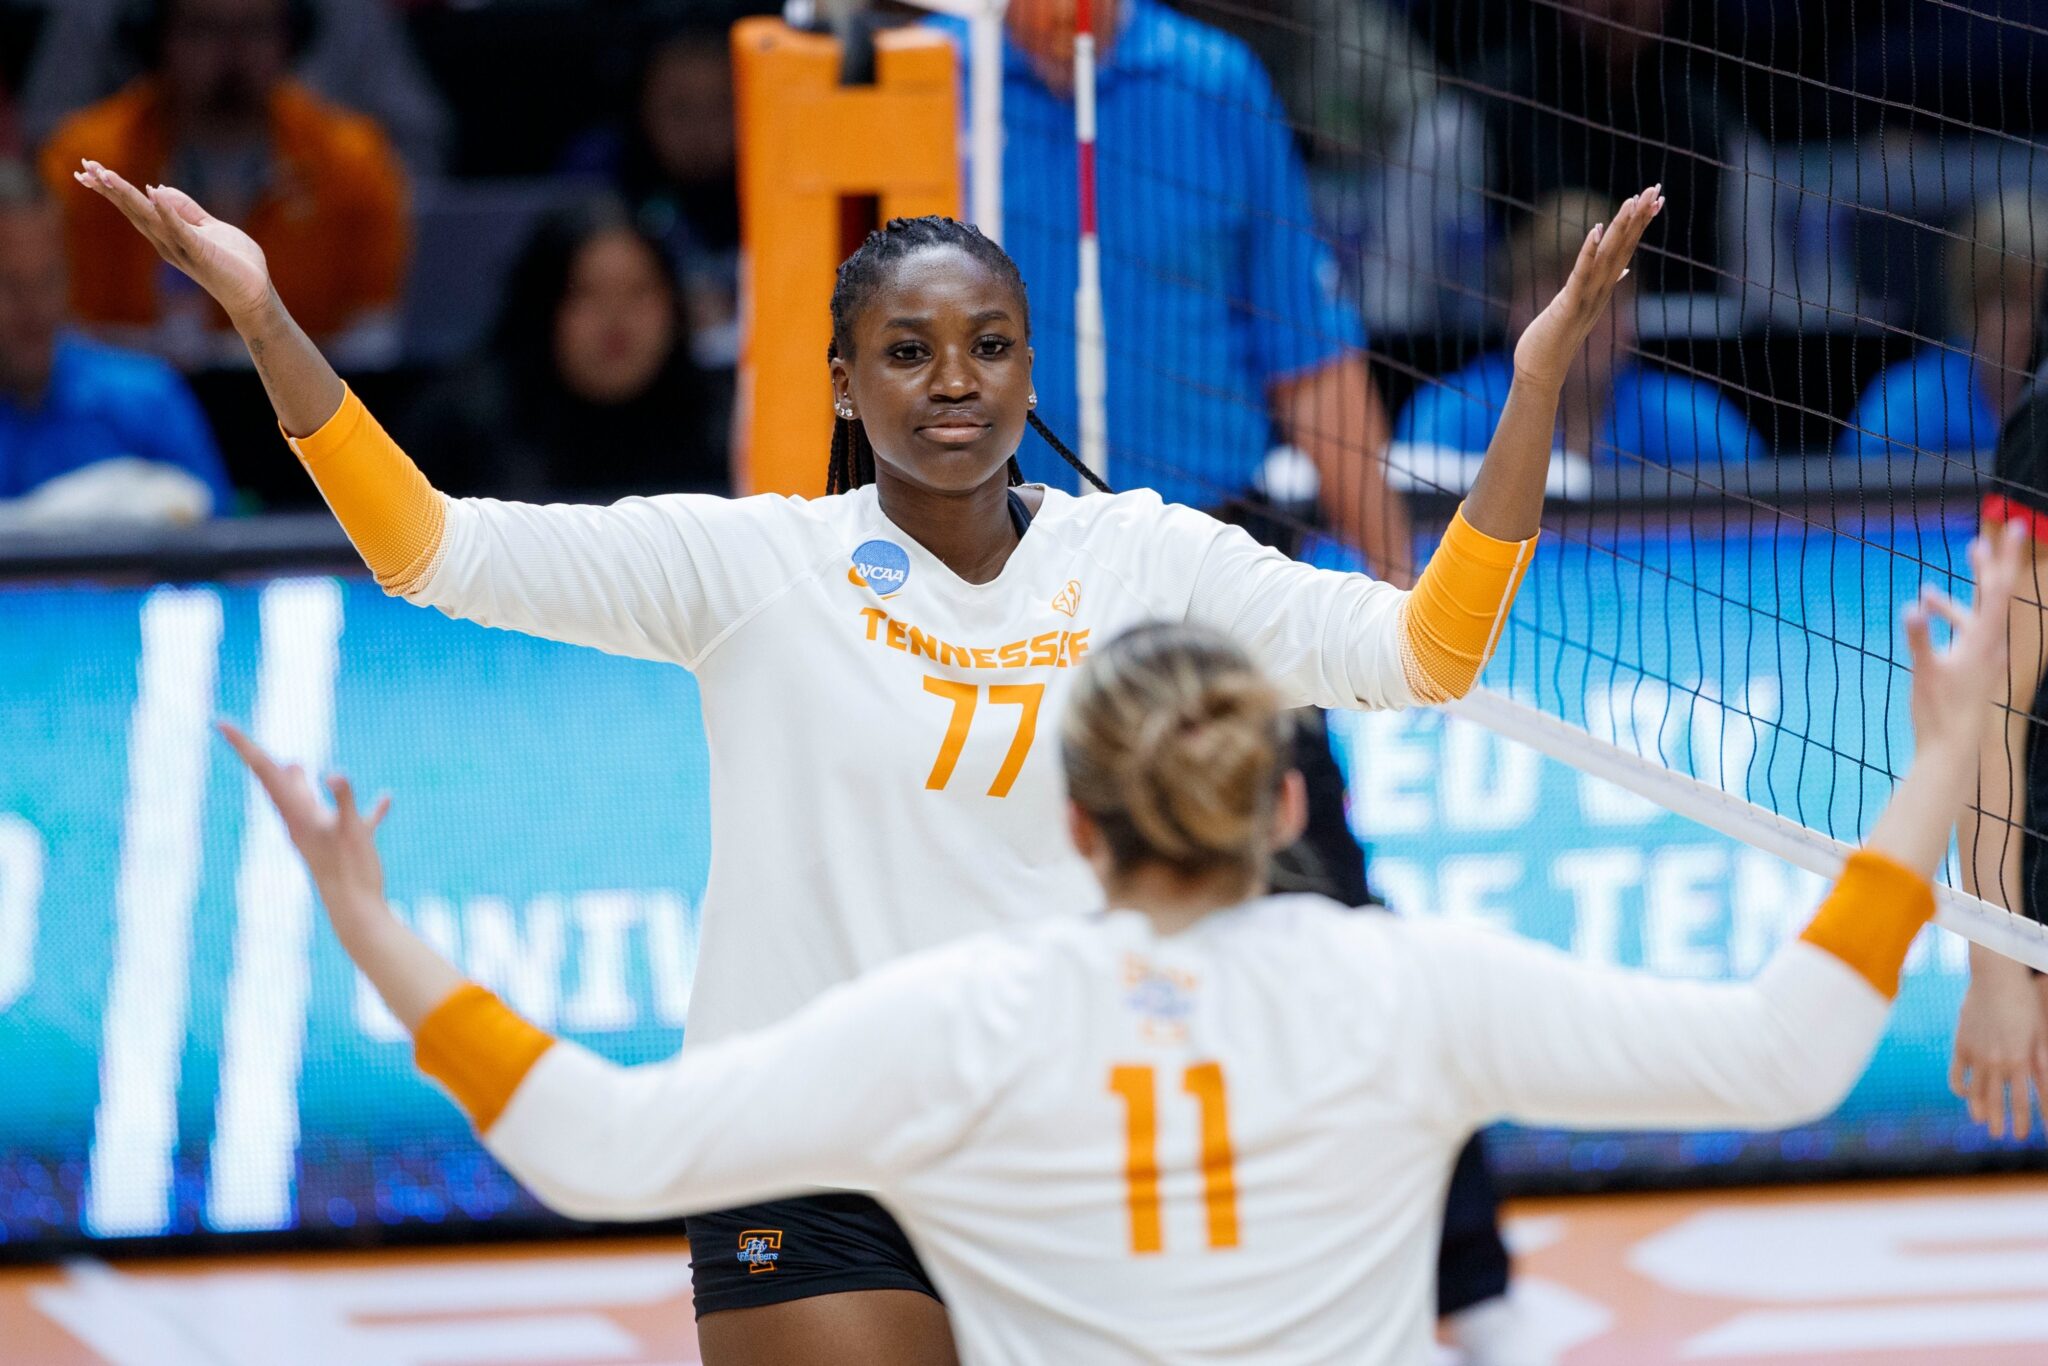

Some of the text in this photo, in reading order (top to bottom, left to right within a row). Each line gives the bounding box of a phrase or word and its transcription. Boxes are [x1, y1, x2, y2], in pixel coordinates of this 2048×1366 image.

[856, 562, 904, 583] NCAA
[922, 674, 1046, 798] 77
[1108, 1061, 1241, 1256] 11
